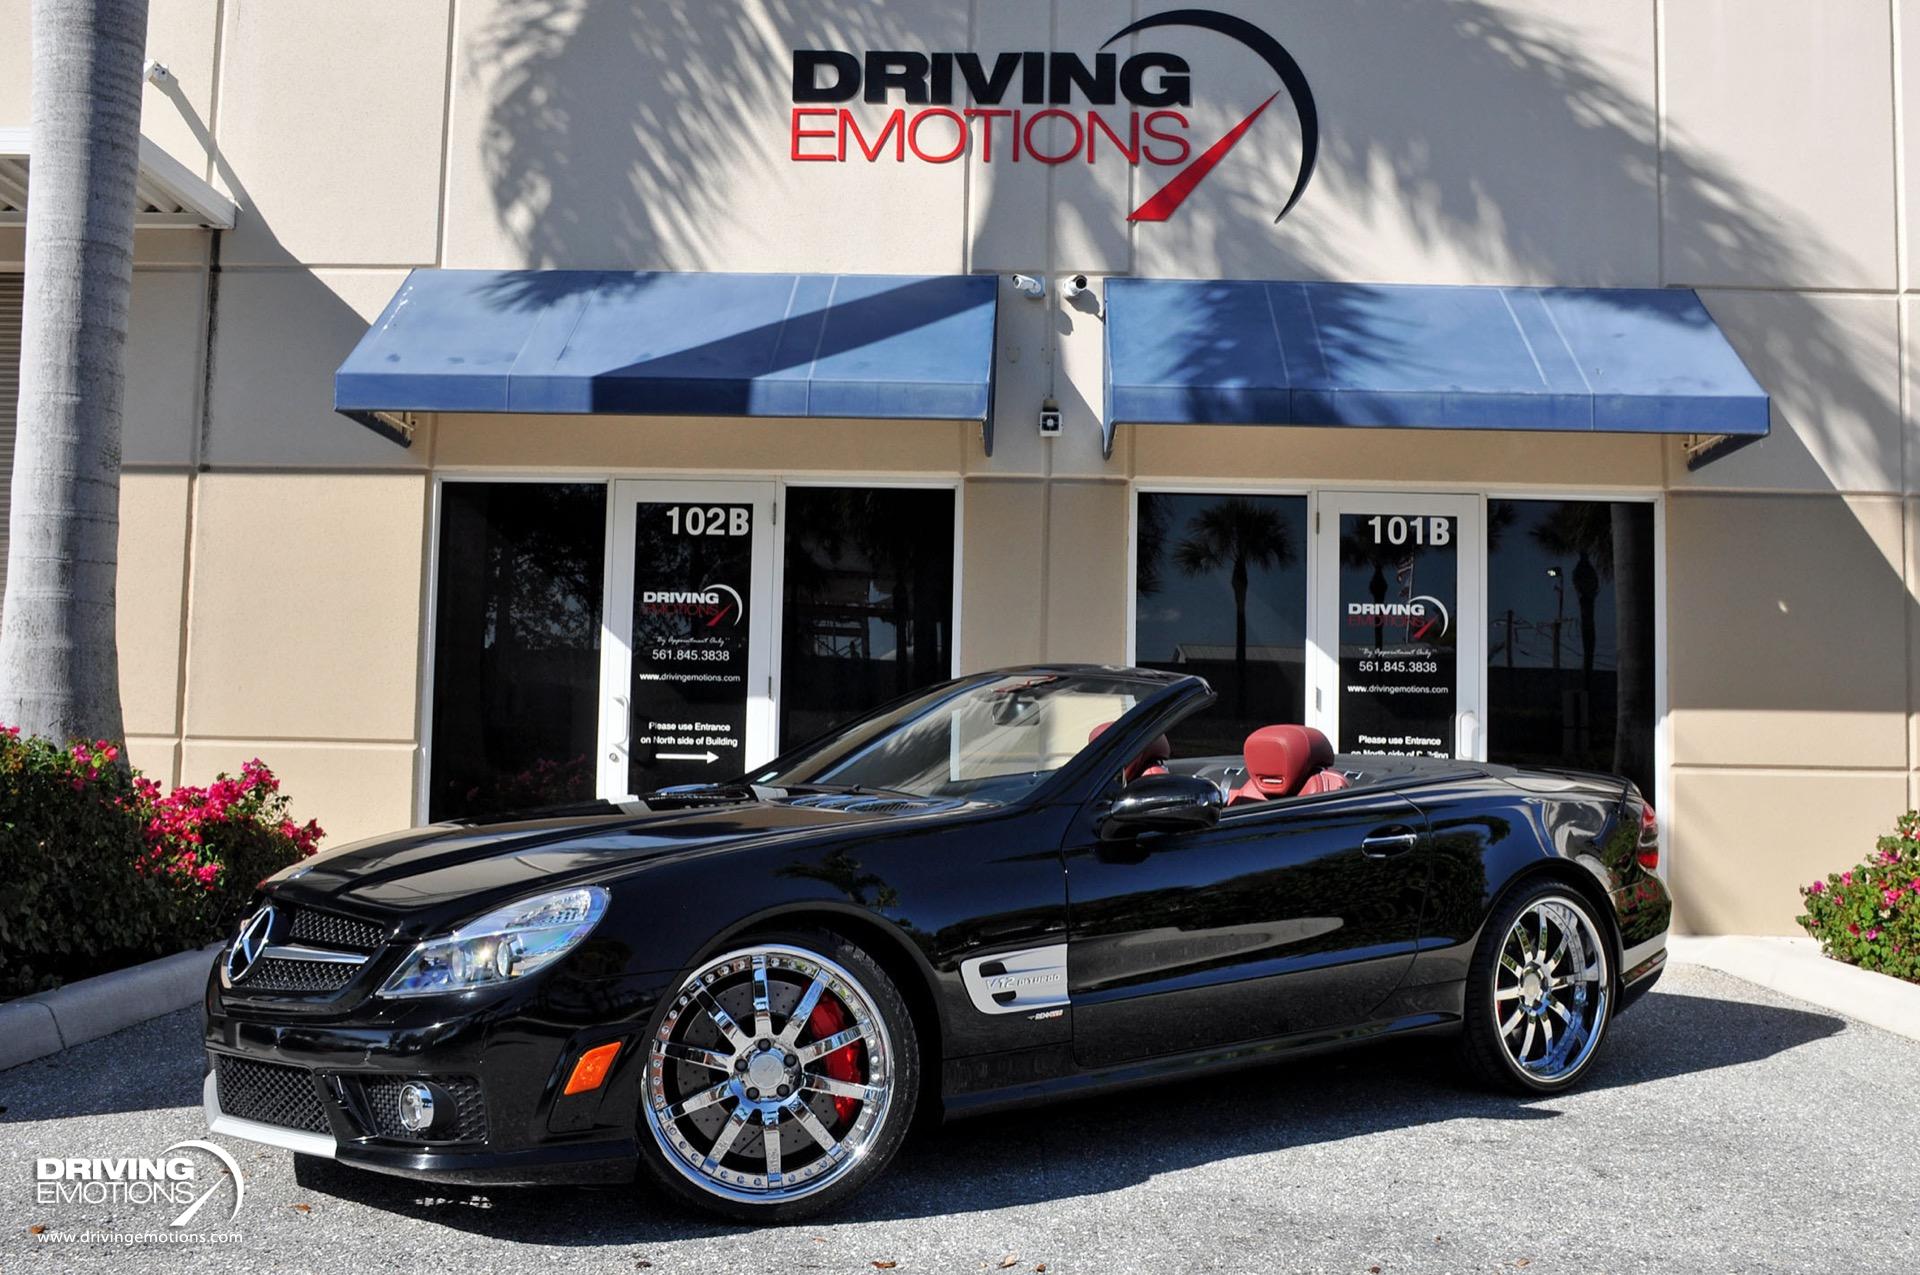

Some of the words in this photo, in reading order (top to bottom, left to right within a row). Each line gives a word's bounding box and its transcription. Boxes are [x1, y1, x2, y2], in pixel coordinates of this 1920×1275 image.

[792, 49, 1190, 107] DRIVING
[791, 107, 1190, 166] EMOTIONS
[666, 506, 749, 536] 102B
[1368, 515, 1450, 546] 101B
[643, 591, 719, 604] DRIVING
[1348, 603, 1425, 616] DRIVING
[668, 635, 709, 646] Appointment
[652, 649, 730, 661] 561.845.3838
[1374, 647, 1416, 657] Appointment
[1359, 661, 1437, 672] 561.845.3838
[640, 673, 740, 682] www.drivingemotions.com
[1347, 684, 1449, 694] www.drivingemotions.com
[648, 721, 677, 731] Please
[678, 723, 693, 731] use
[694, 722, 731, 731] Entrance
[640, 736, 652, 744] on
[653, 736, 676, 744] North
[677, 736, 694, 745] side
[695, 737, 705, 745] of
[705, 736, 738, 748] Building
[1358, 735, 1387, 744] Please
[1388, 737, 1403, 745] use
[1404, 736, 1442, 745] Entrance
